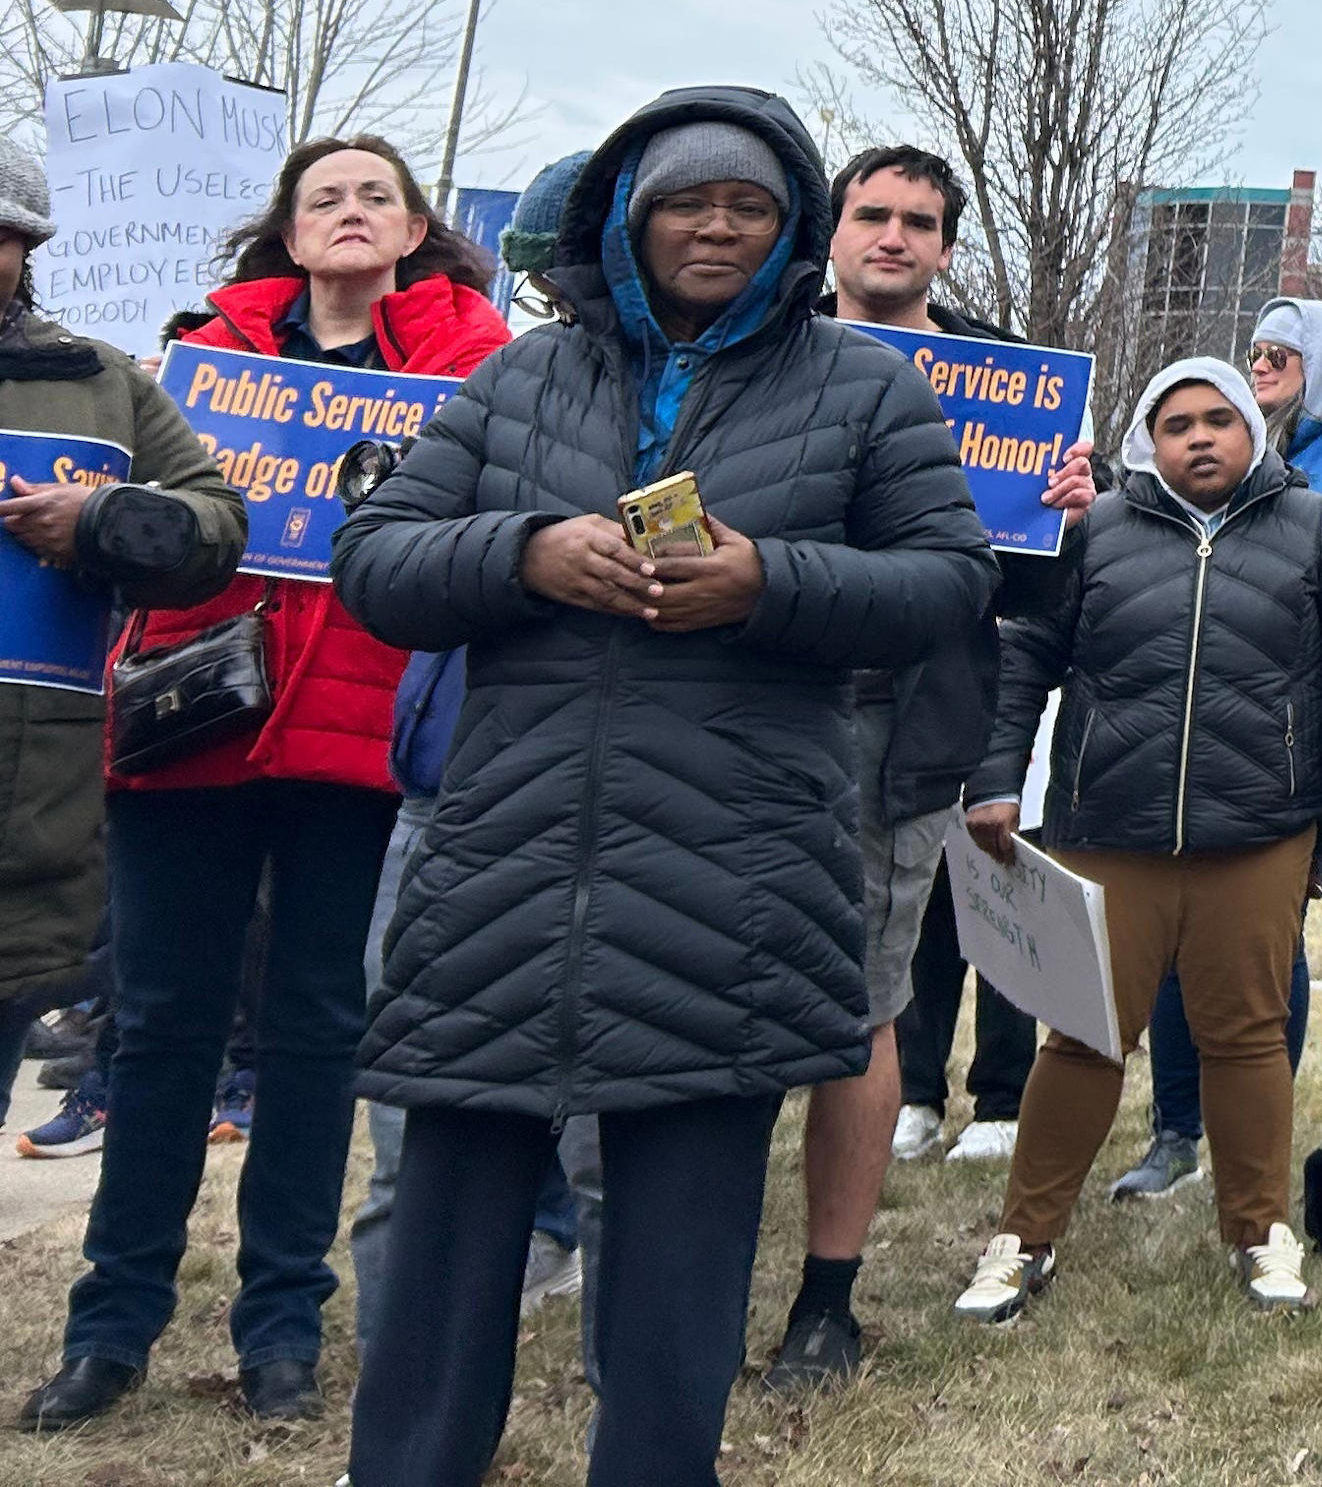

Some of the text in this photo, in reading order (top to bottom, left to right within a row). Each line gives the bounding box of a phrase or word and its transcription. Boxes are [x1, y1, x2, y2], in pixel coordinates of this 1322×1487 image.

[64, 87, 287, 158] ELON MUSK
[156, 164, 270, 207] USELES
[47, 221, 224, 258] GOVERNMEN
[50, 258, 214, 299] EMPLOYEE
[186, 363, 424, 437] Public Service
[1033, 365, 1064, 410] is
[960, 420, 1064, 479] Honor!
